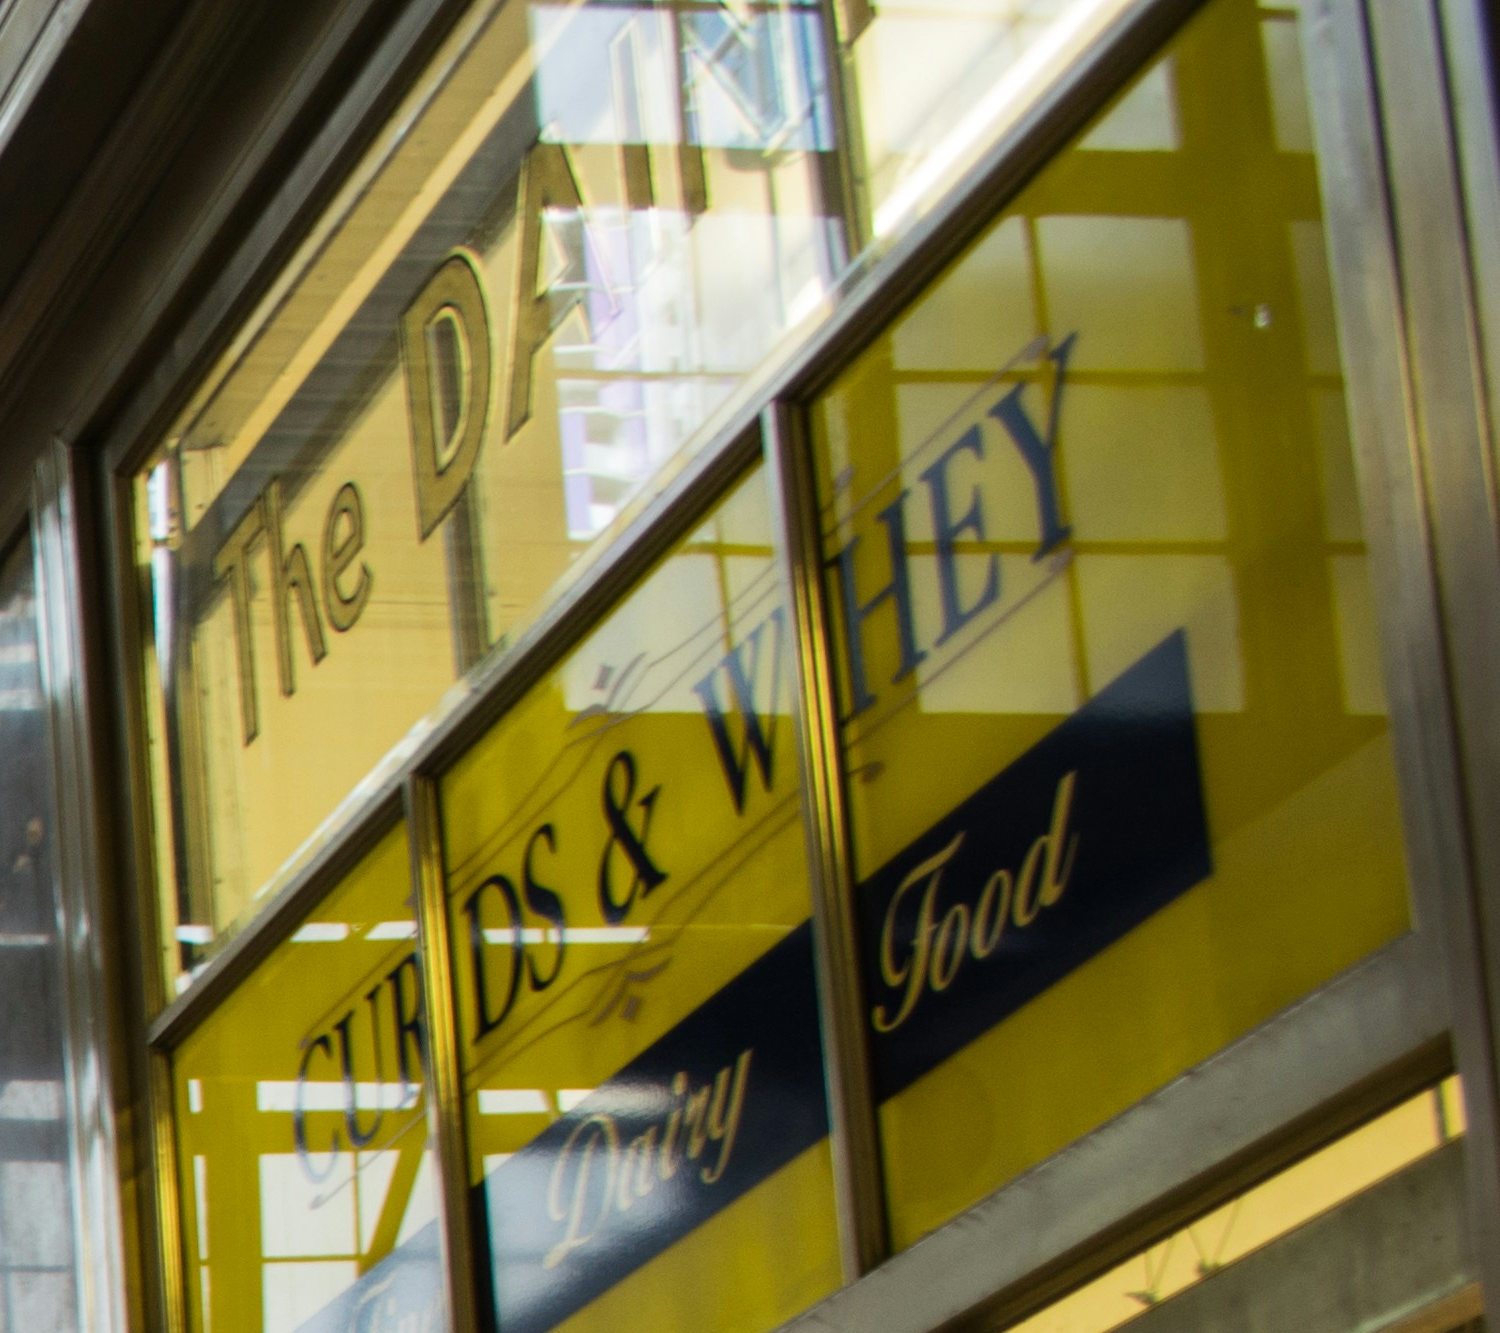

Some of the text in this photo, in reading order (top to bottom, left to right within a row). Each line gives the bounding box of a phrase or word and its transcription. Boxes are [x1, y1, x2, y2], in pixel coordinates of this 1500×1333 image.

[214, 475, 374, 748] The
[598, 750, 668, 928] &
[691, 329, 1080, 818] WHEY
[541, 1047, 753, 1271] Dairy
[872, 769, 1080, 1034] Food
